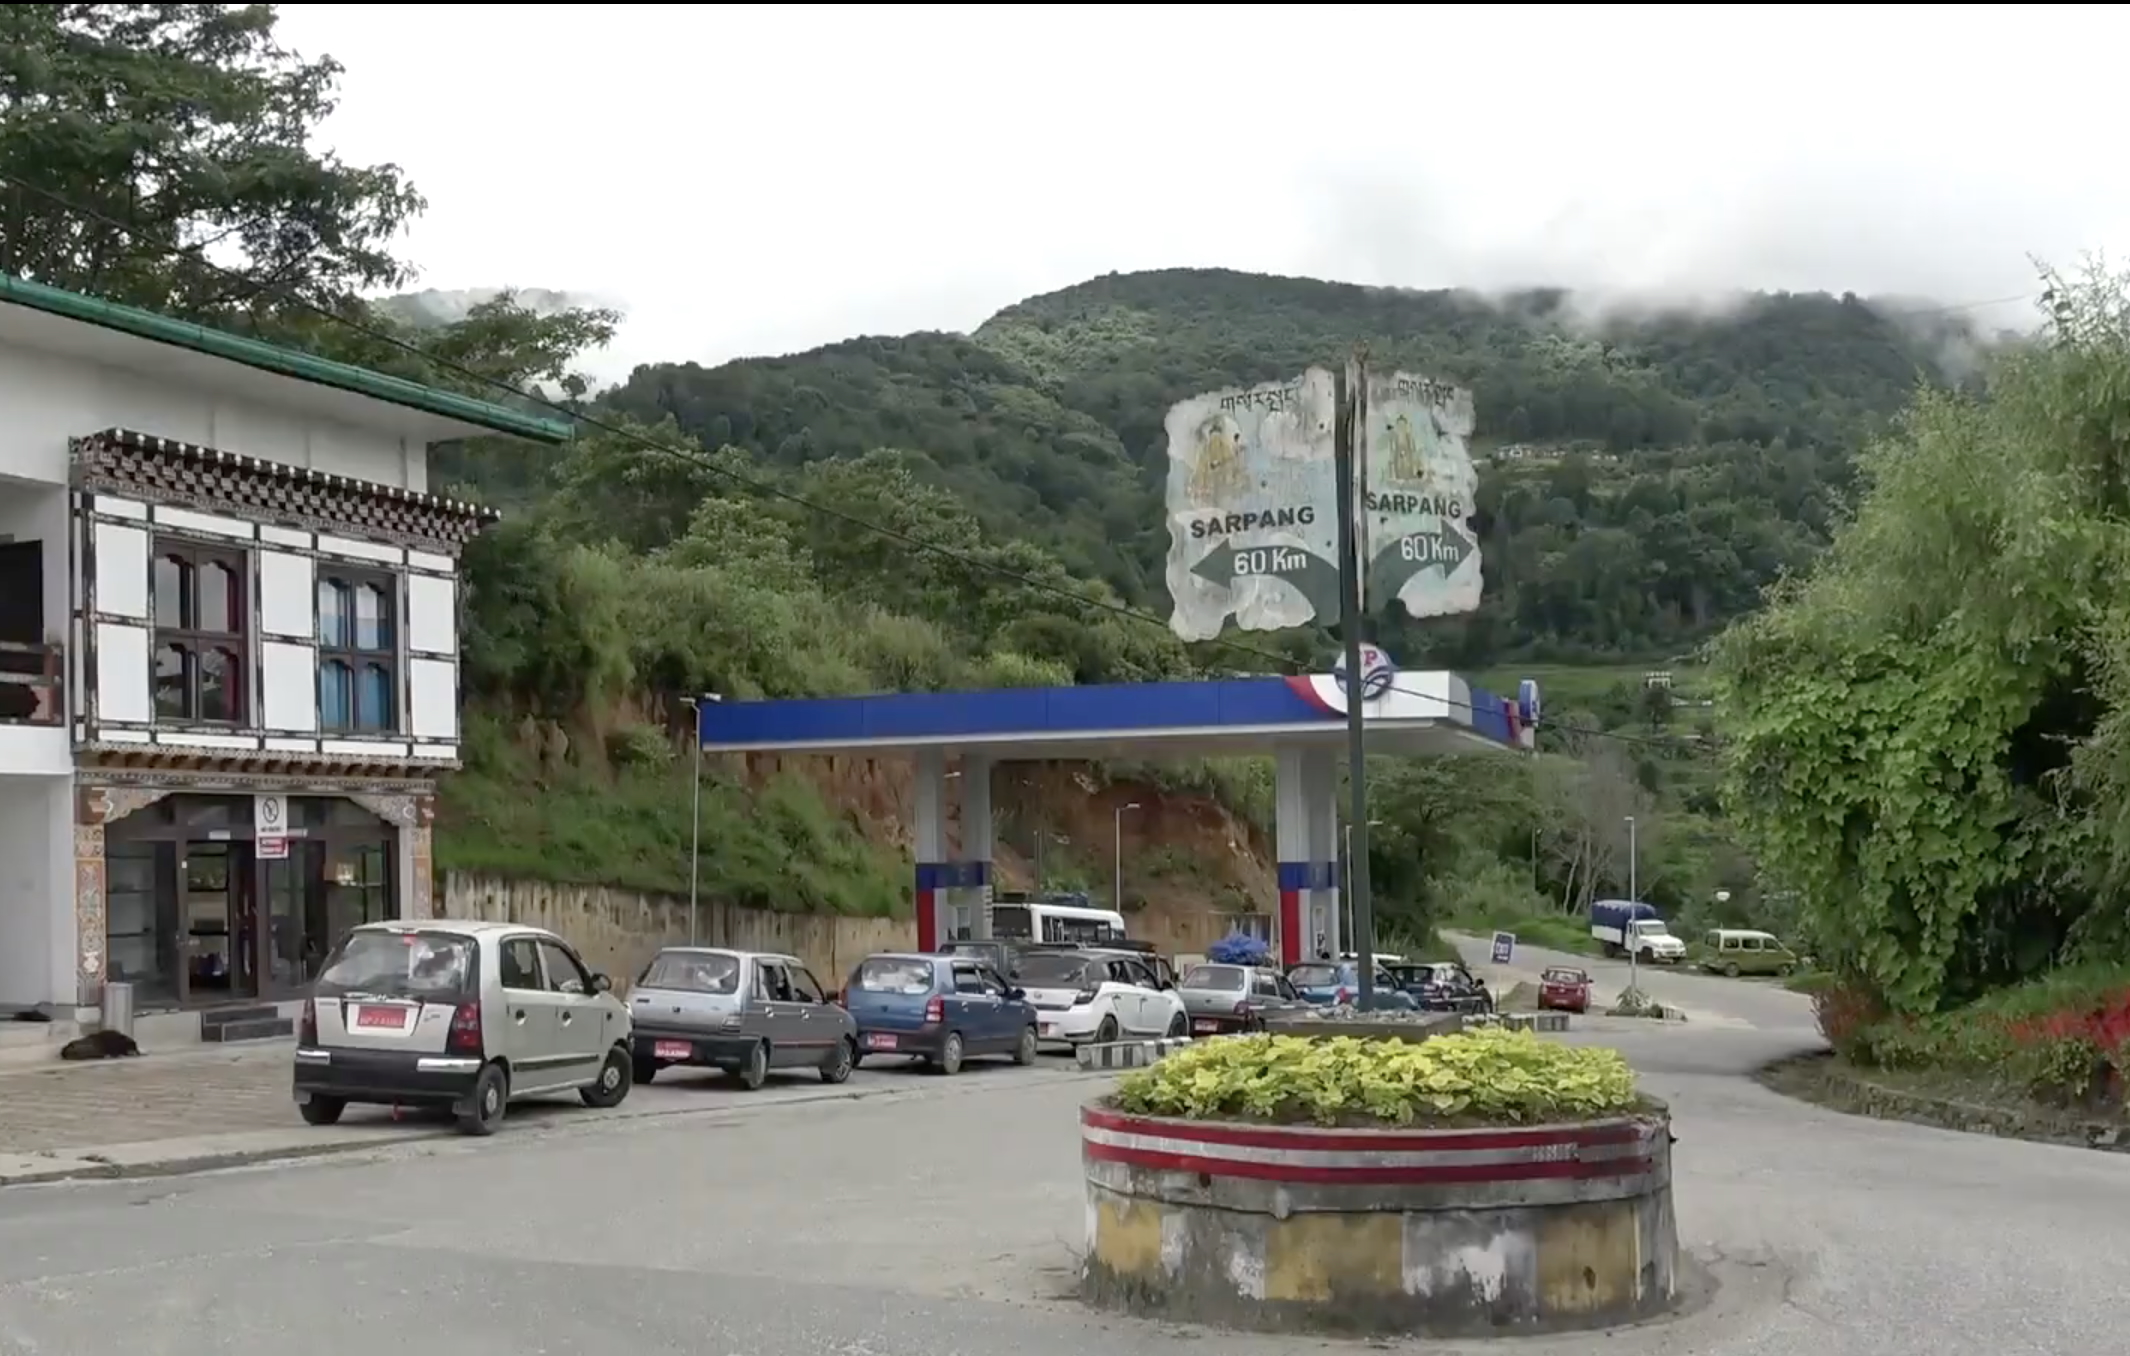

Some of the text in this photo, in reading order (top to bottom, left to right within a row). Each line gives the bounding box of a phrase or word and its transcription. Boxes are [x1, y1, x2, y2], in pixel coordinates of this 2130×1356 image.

[1365, 491, 1461, 519] SARPANG
[1190, 506, 1315, 538] SARPANG
[1234, 547, 1307, 575] 60 Km
[1401, 535, 1460, 562] 60 Km
